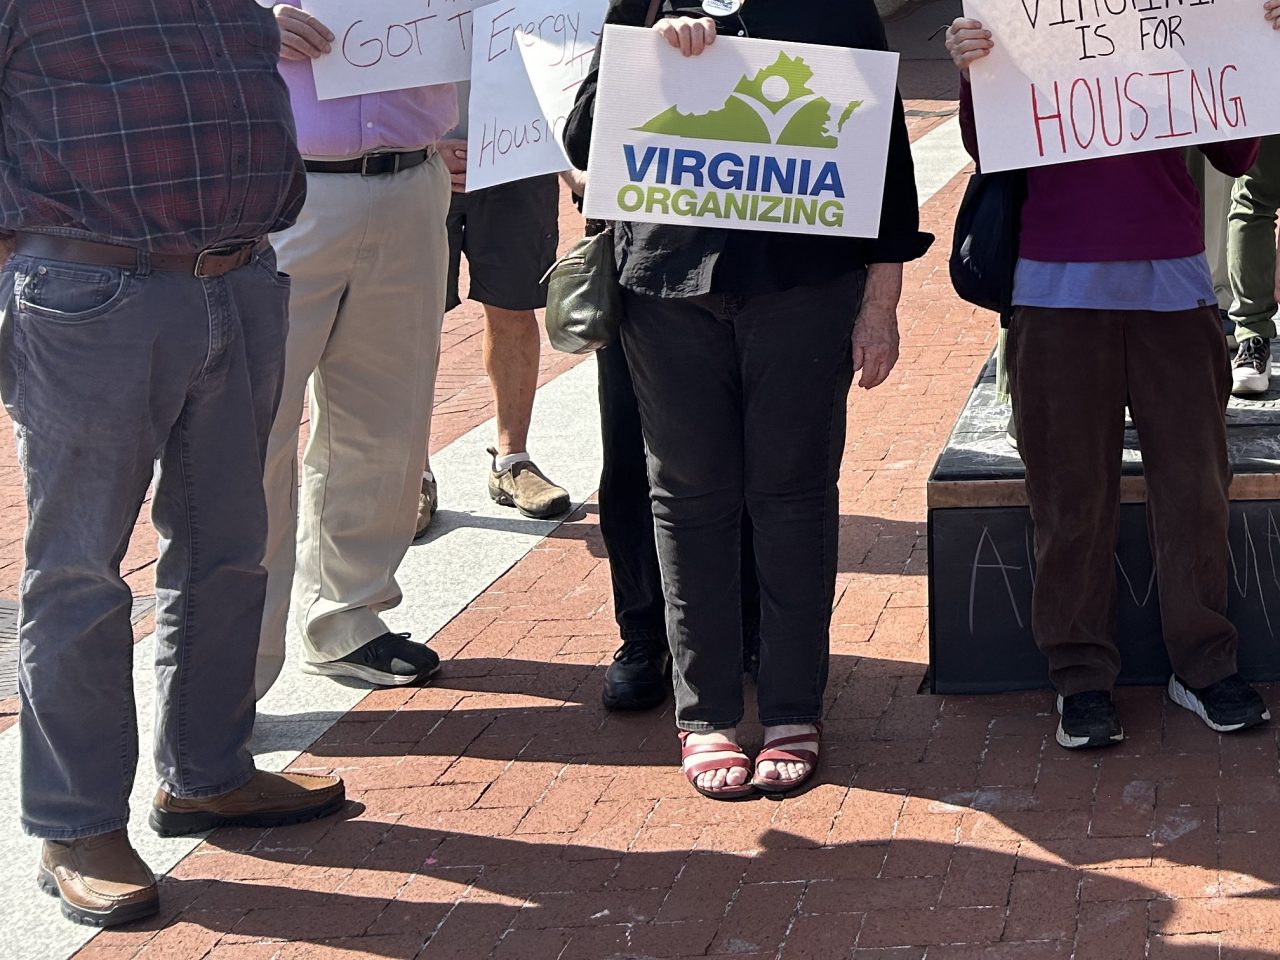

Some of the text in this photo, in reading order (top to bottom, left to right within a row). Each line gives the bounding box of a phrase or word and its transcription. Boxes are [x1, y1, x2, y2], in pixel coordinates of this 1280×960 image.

[342, 10, 473, 68] GOT T
[488, 8, 580, 67] Energy
[1075, 15, 1185, 60] IS FOR
[1030, 64, 1247, 157] HOUSING
[479, 115, 568, 168] Housin
[623, 143, 846, 199] VIRGINIA
[617, 184, 844, 228] ORGANIZING
